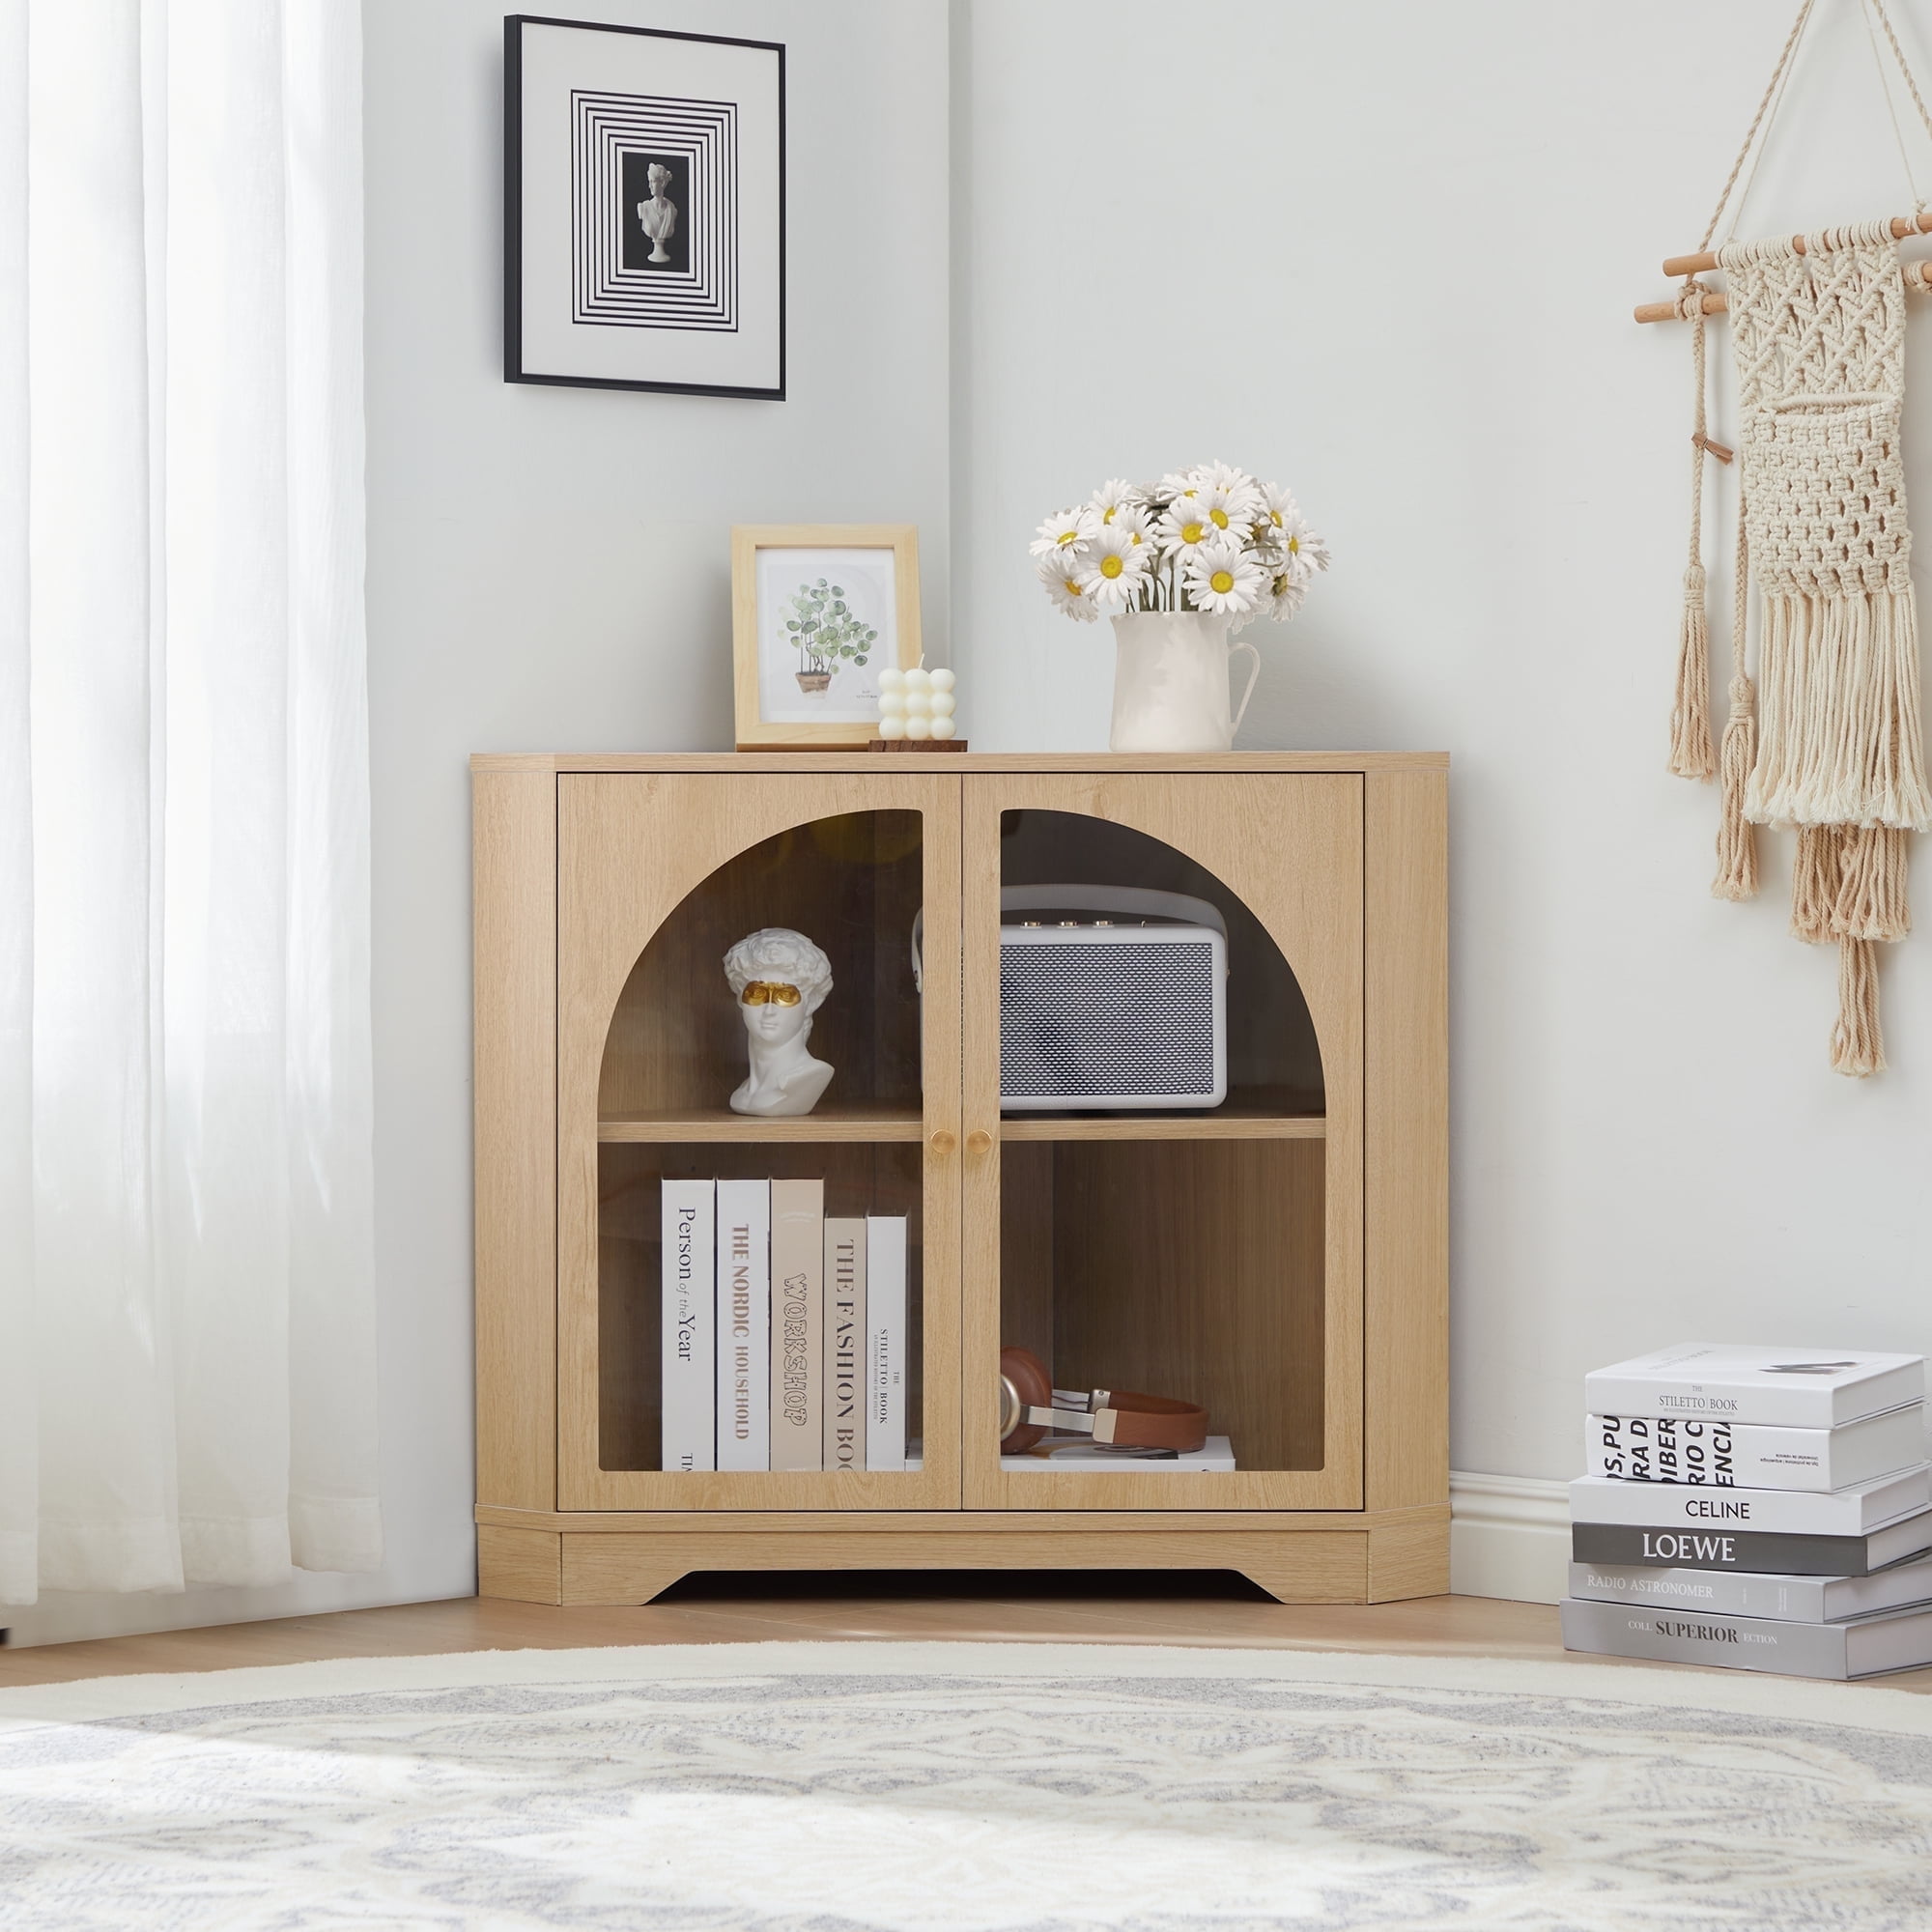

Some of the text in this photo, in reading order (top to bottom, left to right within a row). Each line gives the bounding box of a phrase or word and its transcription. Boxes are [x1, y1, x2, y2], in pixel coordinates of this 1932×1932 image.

[676, 1208, 696, 1362] Person of the Year
[837, 1238, 854, 1293] THE
[732, 1223, 750, 1440] THE NORDIC HOUSEHOLD
[783, 1272, 808, 1427] WORKSHOP
[837, 1301, 855, 1418] FASHION
[1660, 1396, 1738, 1410] STILETTO BOOK
[1686, 1500, 1750, 1520] CELINE
[1643, 1533, 1736, 1562] LOEWE
[1587, 1575, 1714, 1599] RADIO ASTRONOMER
[1655, 1620, 1739, 1644] SUPERIOR
[1743, 1633, 1778, 1645] ECTION
